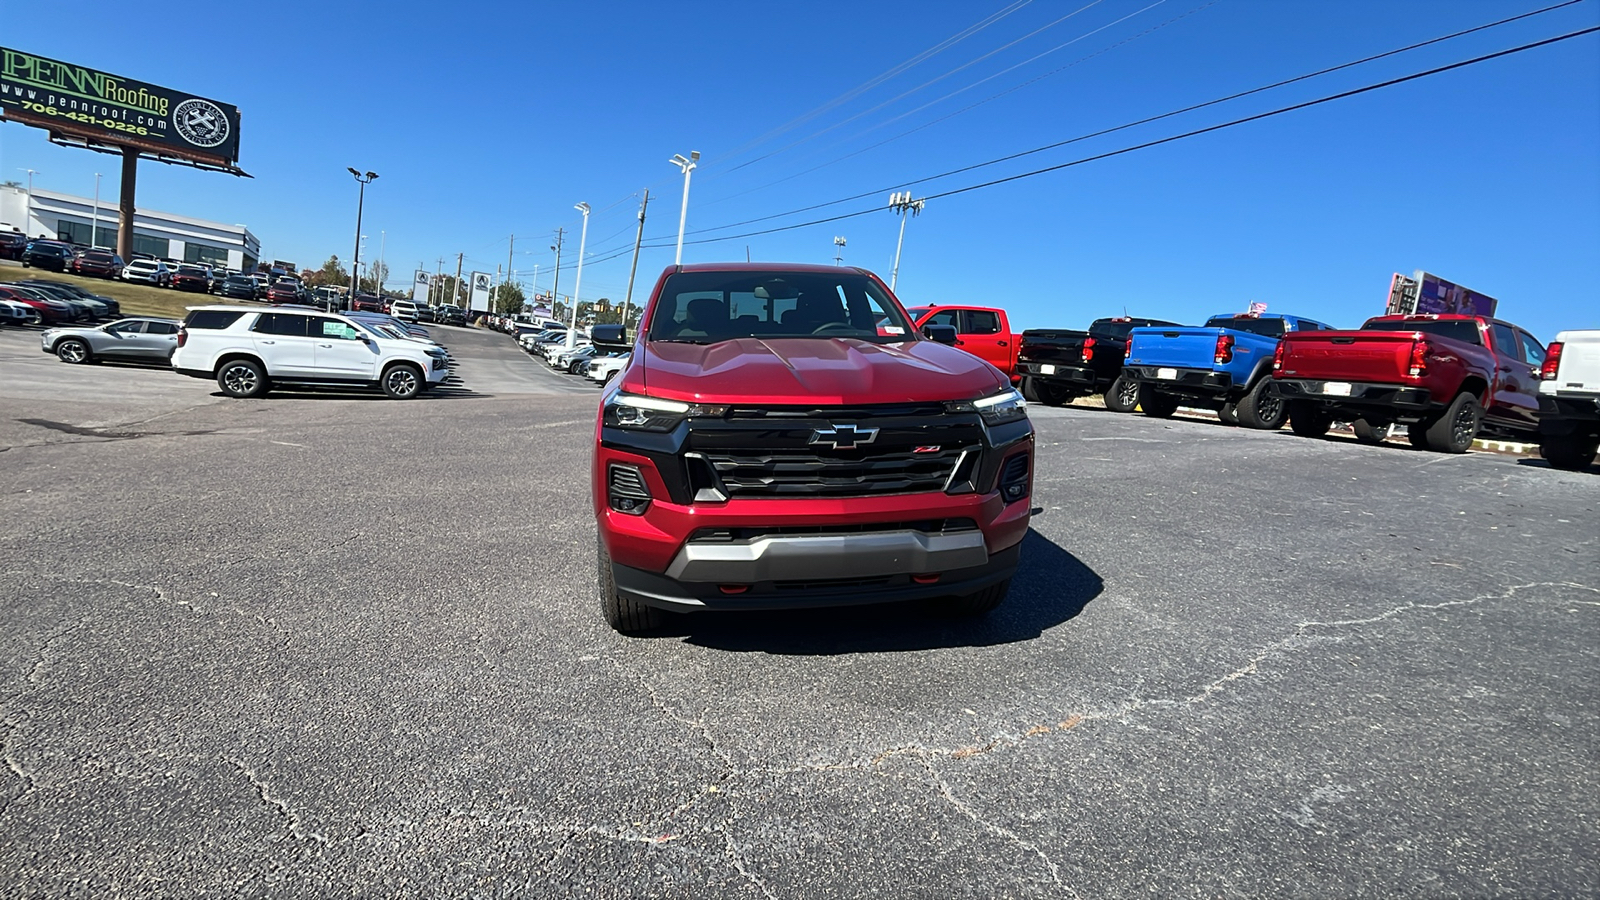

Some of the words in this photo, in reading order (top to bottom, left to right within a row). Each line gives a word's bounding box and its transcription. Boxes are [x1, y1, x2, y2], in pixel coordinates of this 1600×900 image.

[2, 49, 126, 97] PENN
[105, 79, 169, 117] Roofing
[0, 83, 167, 130] www.pennroof.com
[21, 100, 148, 136] 706-421-0226
[178, 102, 207, 117] SUPPORT
[207, 106, 227, 125] LOCAL
[215, 132, 225, 142] GA
